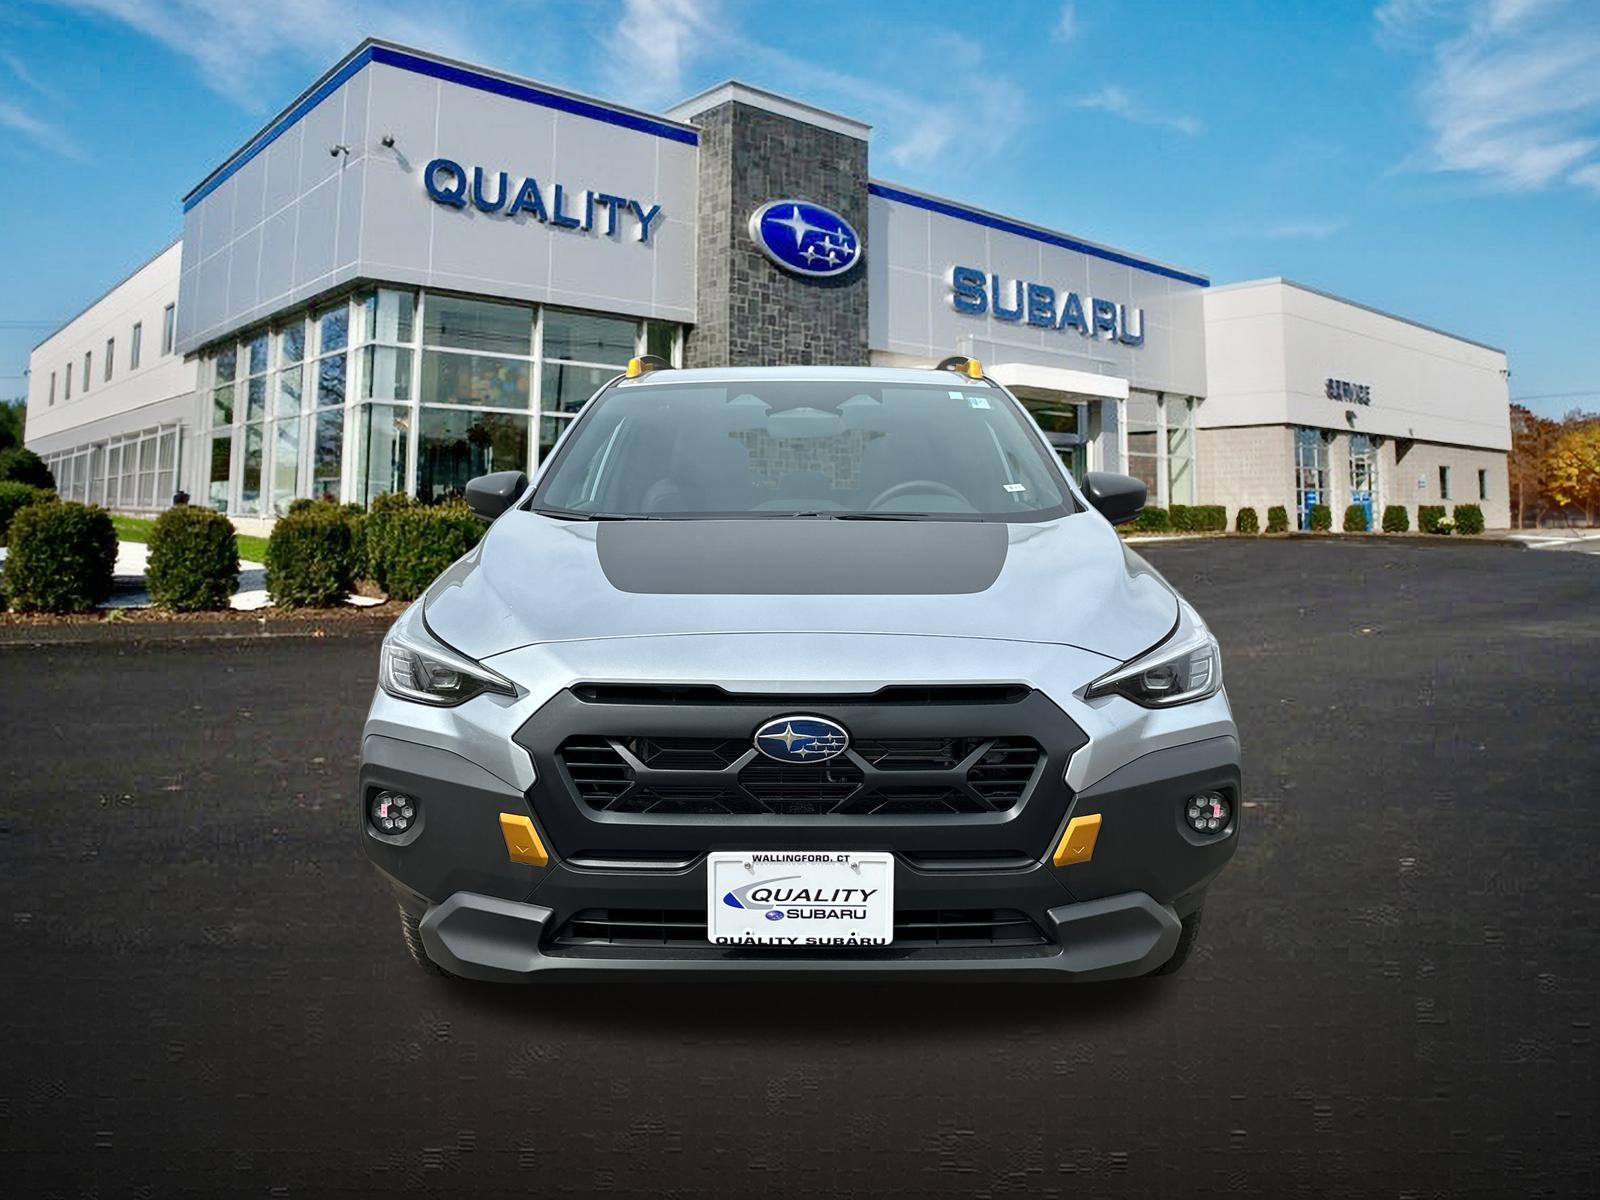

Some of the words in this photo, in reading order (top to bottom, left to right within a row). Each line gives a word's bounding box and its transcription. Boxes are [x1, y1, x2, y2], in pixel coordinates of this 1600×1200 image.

[424, 158, 661, 242] QUALITY
[950, 265, 1144, 346] SUBARU
[837, 854, 850, 862] CT
[751, 888, 878, 903] QUALITY
[786, 909, 867, 920] SUBARU
[715, 937, 799, 945] QUALITY
[805, 937, 886, 945] SUBARU
